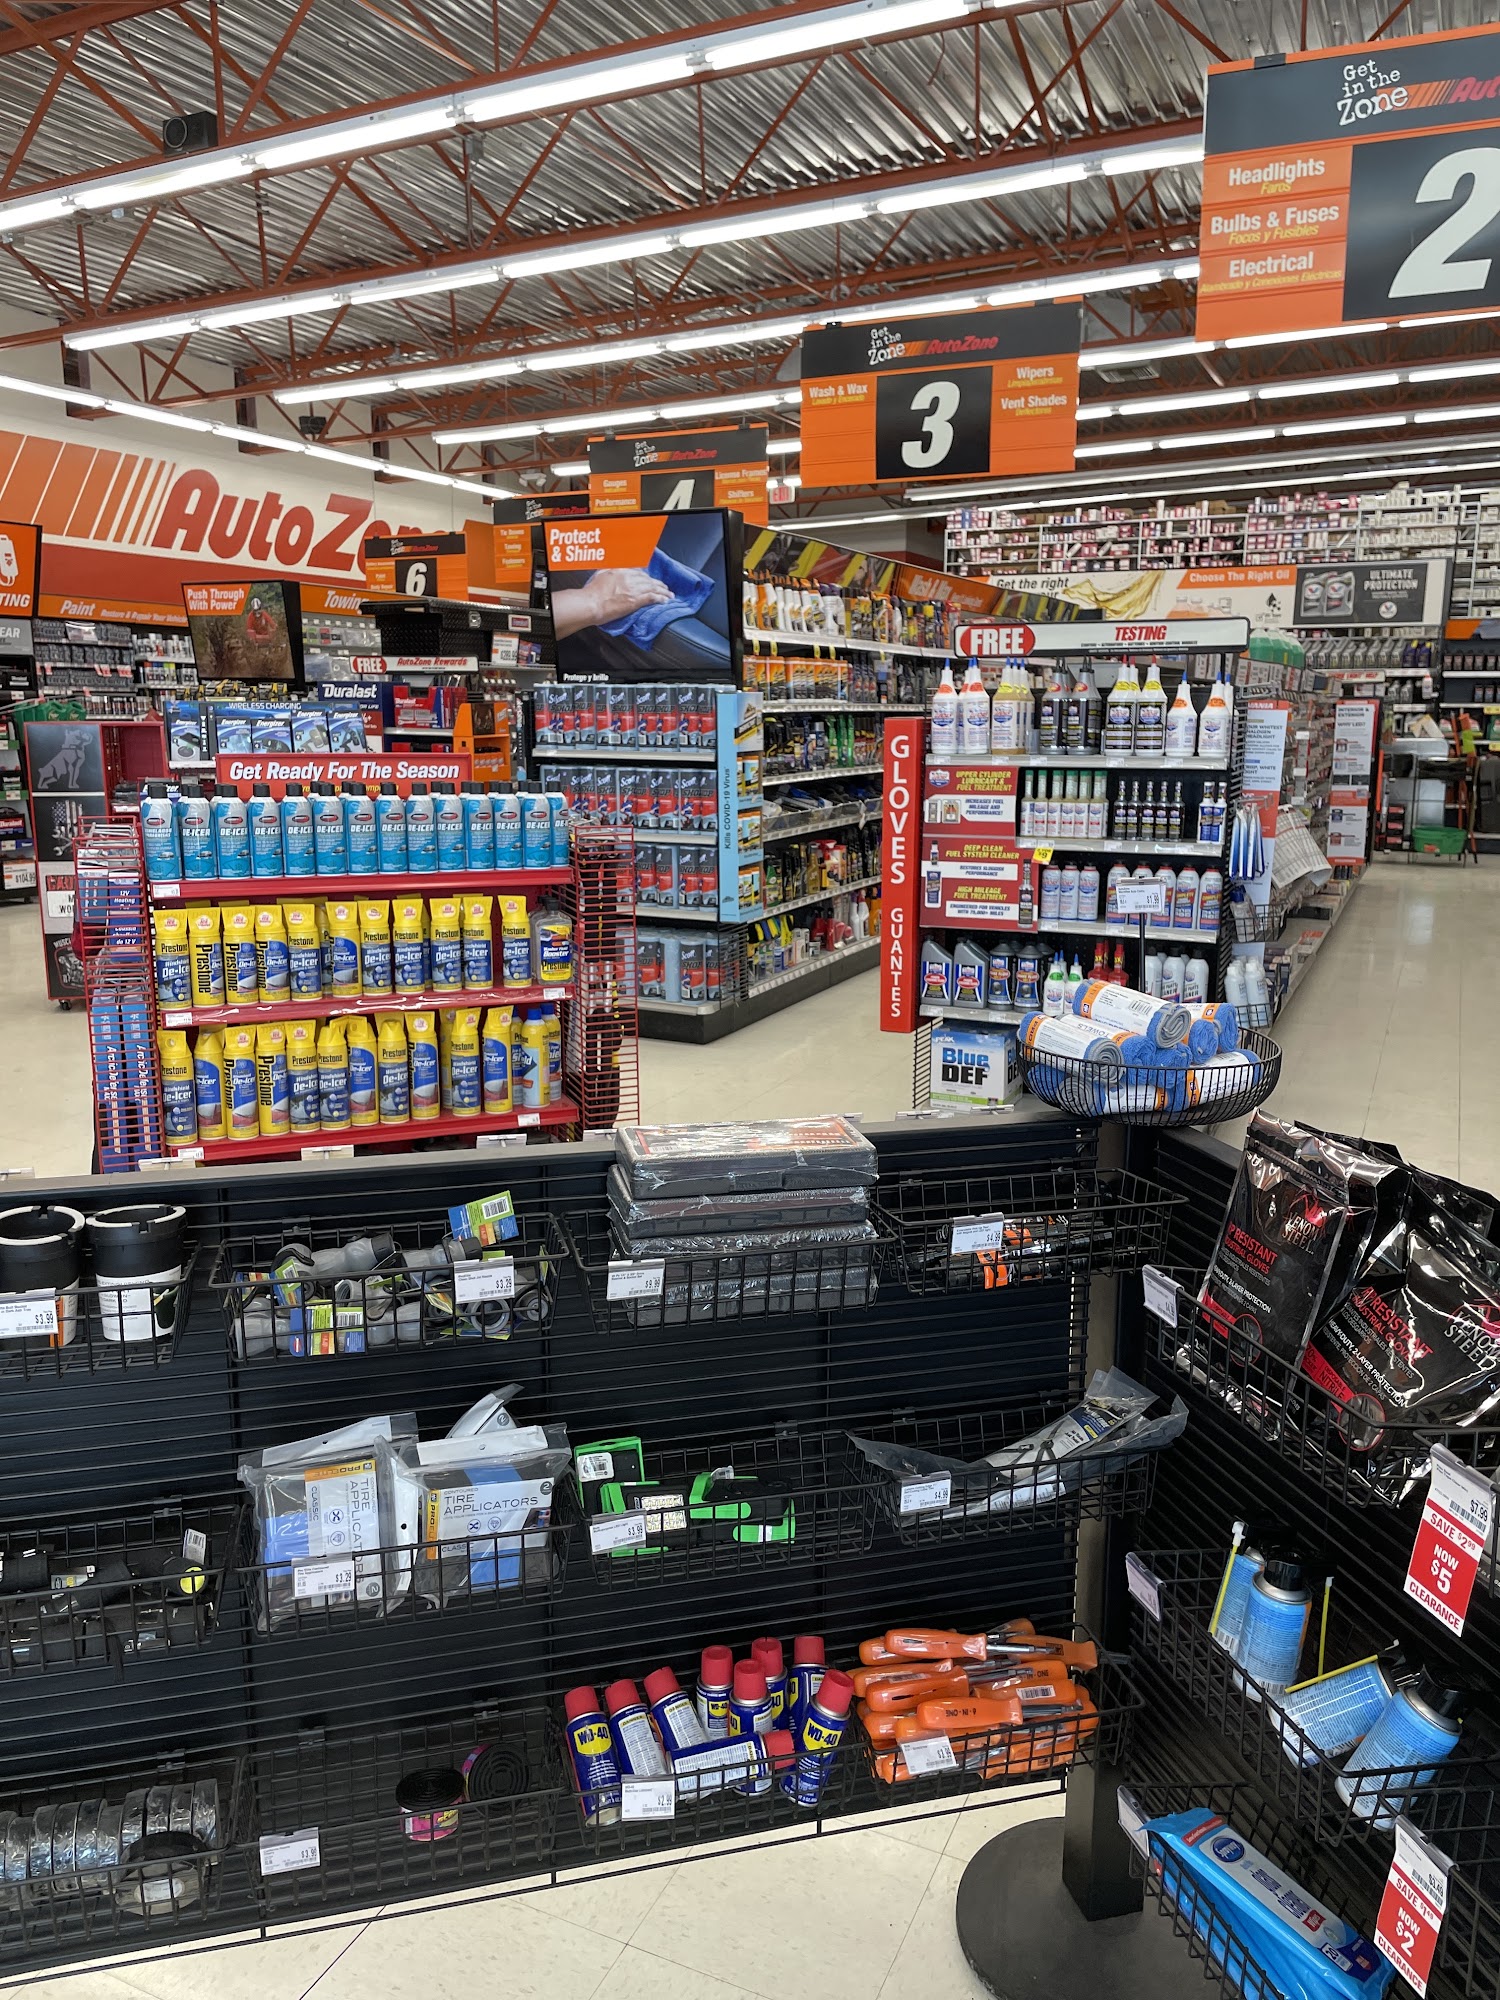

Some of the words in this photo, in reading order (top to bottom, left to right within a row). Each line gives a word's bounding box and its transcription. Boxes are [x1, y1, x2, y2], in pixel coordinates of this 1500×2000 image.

[1343, 59, 1378, 81] Get
[1342, 83, 1365, 99] in
[1369, 69, 1401, 90] the
[1336, 86, 1409, 126] Zone
[1447, 75, 1500, 105] Aut
[1229, 158, 1325, 187] Headlights
[1260, 181, 1292, 195] Faros
[1211, 212, 1261, 236] Bulbs
[1267, 210, 1280, 227] &
[1286, 205, 1340, 226] Fuses
[1387, 147, 1500, 299] 2
[1229, 231, 1261, 245] Focos
[1262, 231, 1271, 243] y
[1274, 224, 1319, 241] Fusibles
[1229, 251, 1314, 278] Electrical
[870, 326, 889, 339] Get
[870, 339, 883, 348] in
[884, 332, 901, 343] the
[868, 342, 906, 366] Zone
[926, 335, 999, 354] AutoZone
[1017, 366, 1054, 381] Wipers
[809, 385, 835, 398] Wash
[837, 385, 845, 395] &
[847, 383, 868, 395] Wax
[1001, 397, 1025, 410] Vent
[1027, 394, 1067, 408] Shades
[901, 381, 961, 469] 3
[633, 452, 658, 467] Zone
[672, 449, 717, 461] AutoZone
[603, 479, 627, 489] Gauges
[595, 497, 636, 507] Performance
[152, 469, 446, 577] AutoZo
[550, 528, 601, 545] Protect
[551, 548, 562, 562] &
[565, 546, 605, 562] Shine
[405, 562, 428, 596] 6
[997, 578, 1016, 590] Get
[1019, 577, 1038, 590] the
[1040, 576, 1069, 591] right
[1189, 571, 1226, 583] Choose
[1228, 571, 1245, 581] The
[1247, 570, 1274, 583] Right
[1276, 569, 1290, 579] Oil
[1369, 569, 1413, 580] ULTIMATE
[187, 588, 208, 600] Push
[210, 588, 244, 600] Through
[1364, 580, 1419, 591] PROTECTION
[60, 600, 96, 617] Paint
[189, 600, 209, 610] With
[211, 600, 237, 610] Power
[969, 627, 1025, 656] FREE
[1115, 625, 1167, 641] TESTING
[358, 658, 382, 673] FREE
[398, 658, 431, 666] AutoZone
[434, 657, 467, 665] Rewards
[322, 683, 378, 699] Duralast
[267, 702, 301, 710] CHARGING
[297, 710, 322, 718] Energizer
[230, 762, 262, 780] Get
[267, 762, 323, 782] Ready
[328, 762, 357, 779] For
[361, 761, 391, 778] The
[397, 762, 459, 779] Season
[890, 735, 910, 884] GLOVES
[364, 932, 389, 941] Prestone
[161, 943, 188, 953] Prestone
[543, 949, 569, 958] Booster
[196, 944, 212, 993] Prestone
[226, 943, 240, 992] Prestone
[541, 962, 569, 970] Prestone
[890, 907, 904, 1018] GUANTES
[942, 1047, 989, 1067] Blue
[258, 1055, 274, 1106] Prestone
[942, 1064, 988, 1085] DEF
[1289, 1211, 1320, 1241] VENOM
[986, 1233, 1001, 1244] $4.99
[1234, 1228, 1278, 1265] RESISTANT
[1282, 1228, 1315, 1256] STEEL
[1246, 1254, 1270, 1275] GLOVES
[496, 1278, 512, 1289] $3.29
[645, 1278, 660, 1290] $9.99
[1244, 1290, 1273, 1314] PROTECTION
[34, 1312, 54, 1325] $3.99
[1370, 1295, 1434, 1360] RESISTANT
[1444, 1324, 1495, 1370] STEEL
[1328, 1319, 1355, 1353] HEAVY-DUTY,
[1352, 1347, 1375, 1375] 2-LAYER
[1371, 1367, 1409, 1407] PROTECTION
[1320, 1371, 1345, 1400] NITRILE
[361, 1480, 371, 1512] TIRE
[443, 1486, 479, 1495] CONTOURED
[444, 1493, 475, 1505] TIRE
[934, 1490, 948, 1501] $4.99
[310, 1485, 319, 1522] CLASSIC
[443, 1496, 539, 1515] APPLICATORS
[1470, 1499, 1488, 1522] $7.99
[350, 1480, 364, 1584] APPLICATORS
[628, 1525, 644, 1537] $3.99
[1430, 1513, 1455, 1540] SAVE
[1434, 1543, 1460, 1571] NOW
[335, 1572, 352, 1584] $3.29
[1430, 1559, 1453, 1595] $5
[1409, 1581, 1461, 1630] CLEARANCE
[710, 1702, 728, 1710] WD-40
[621, 1714, 647, 1727] DANGER
[577, 1726, 608, 1746] WD-40
[806, 1726, 838, 1748] WD-40
[657, 1795, 672, 1807] $2.99
[1396, 1877, 1419, 1906] SAVE
[1428, 1873, 1444, 1897] $3.49
[1397, 1907, 1421, 1936] NOW
[1395, 1921, 1415, 1958] $2
[1377, 1935, 1423, 1992] CLEARANCE
